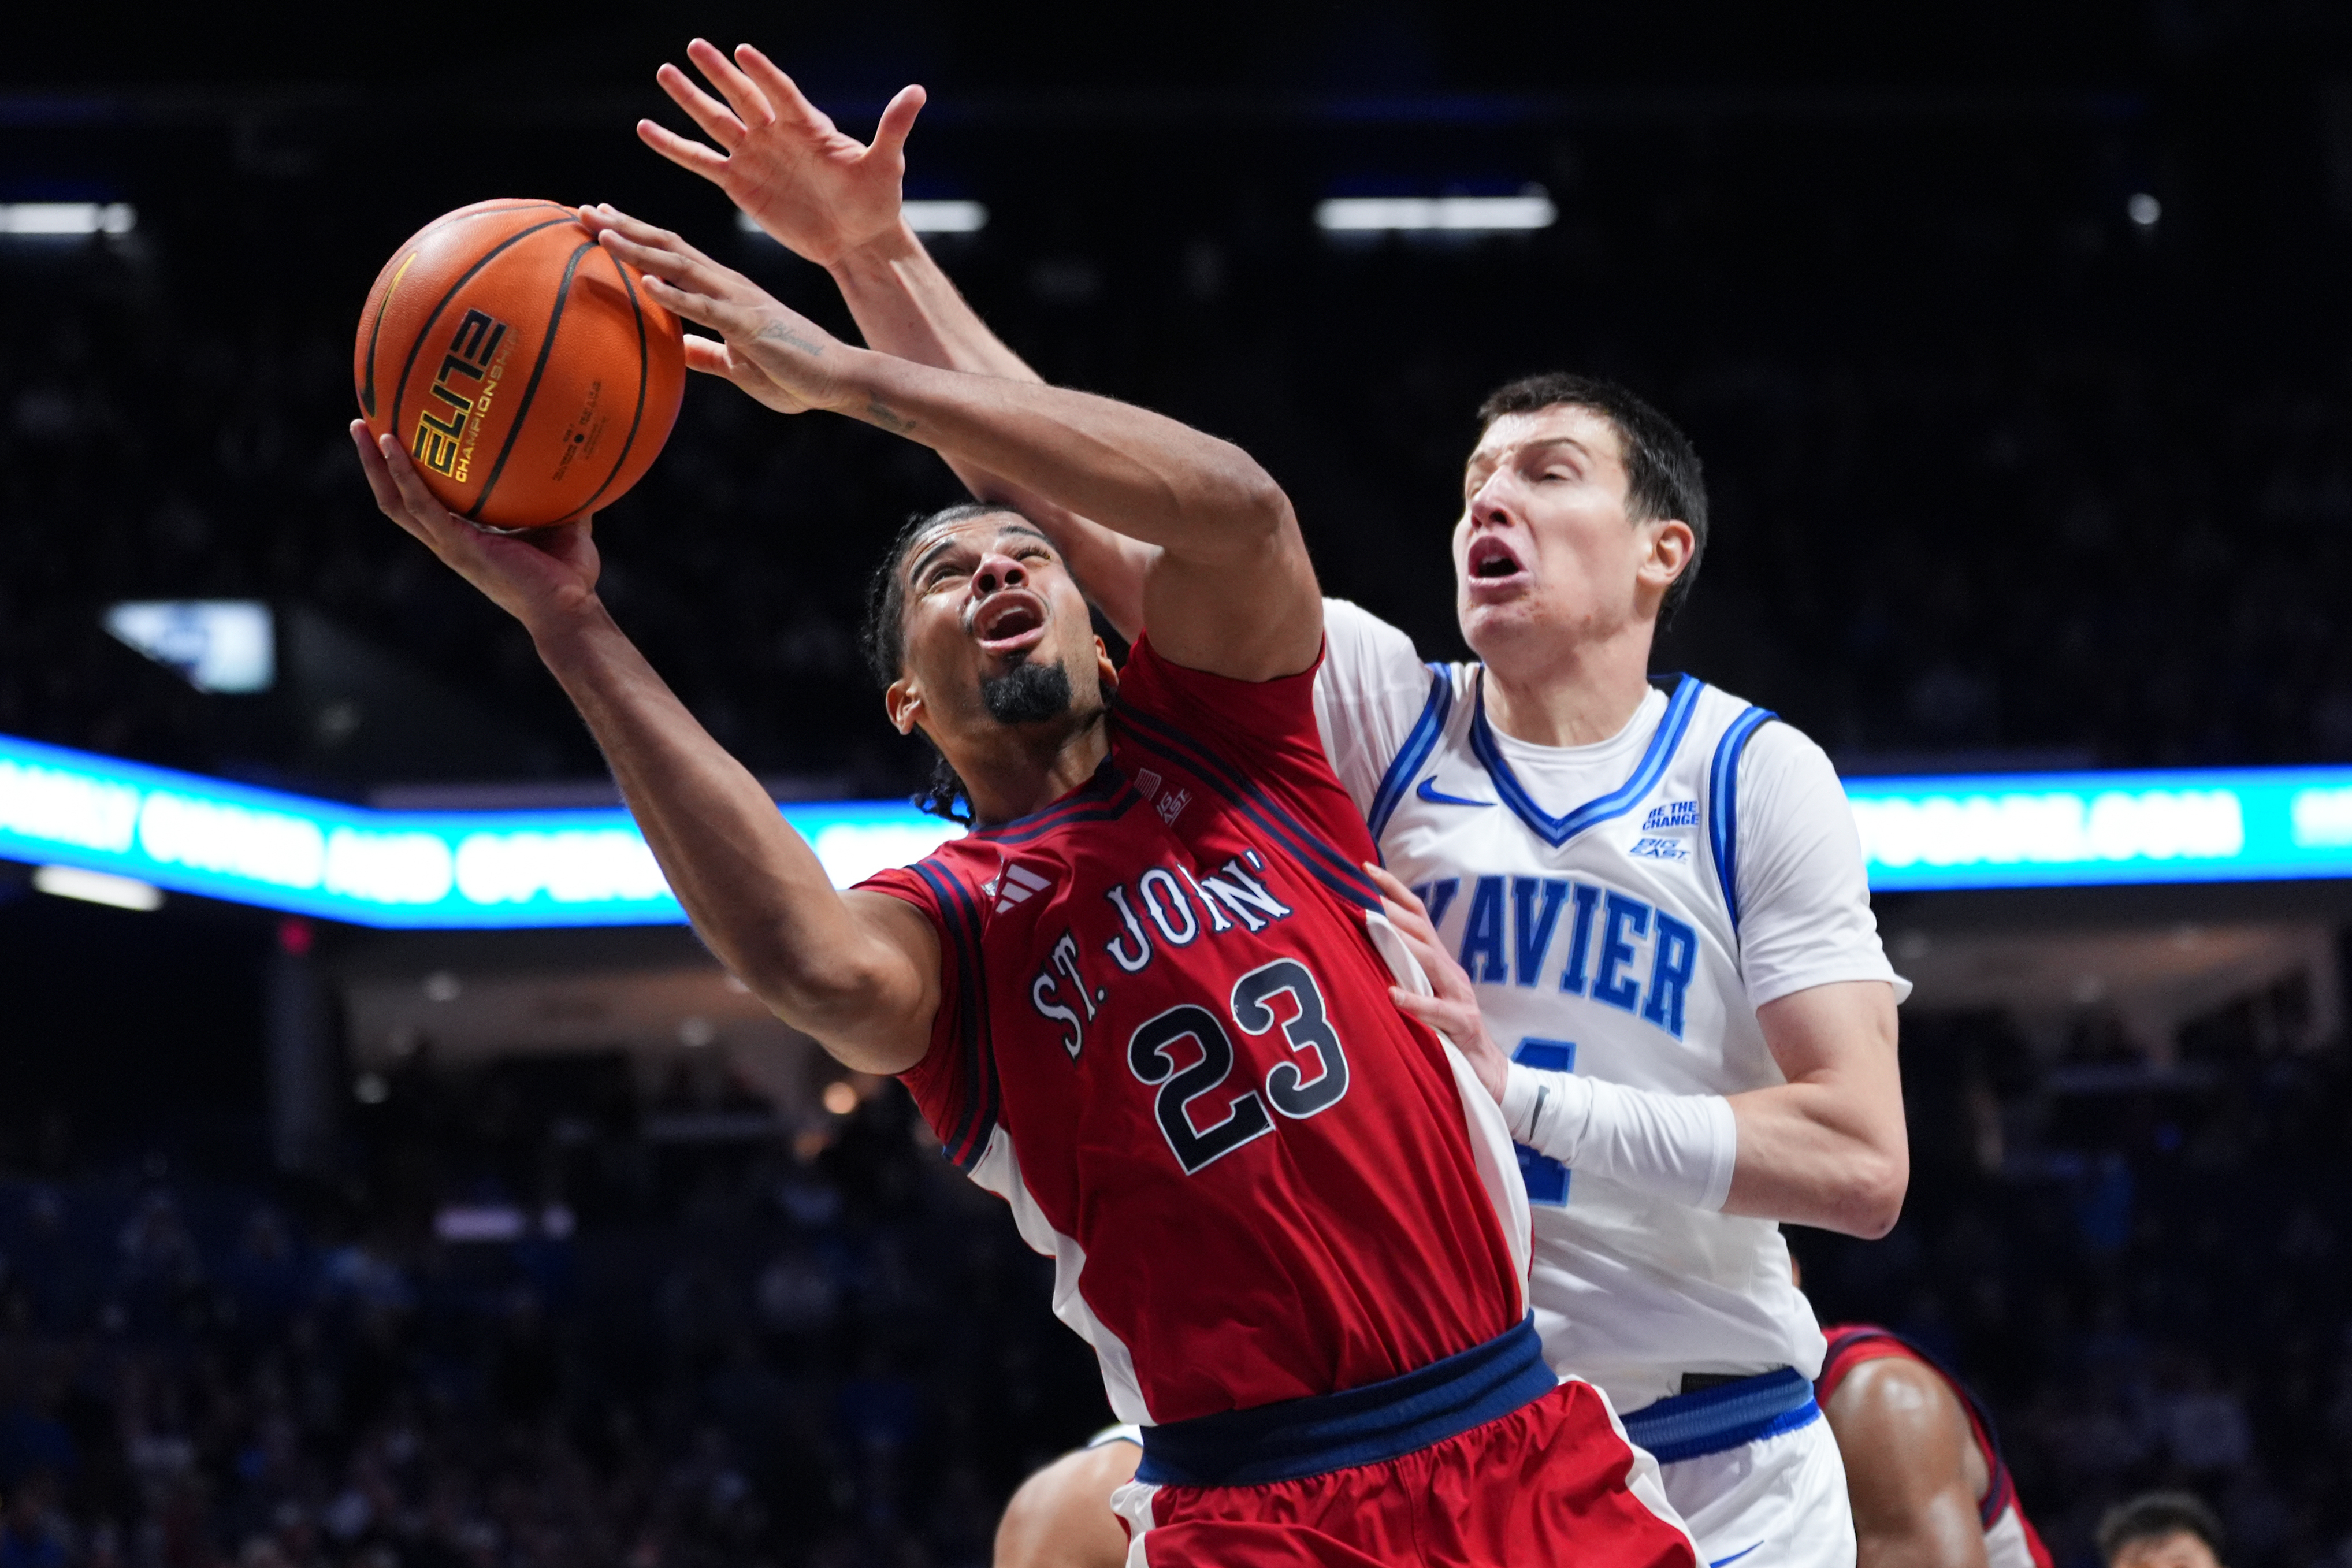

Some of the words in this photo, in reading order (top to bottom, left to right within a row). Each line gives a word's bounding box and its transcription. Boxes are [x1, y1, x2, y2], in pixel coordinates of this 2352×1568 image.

[413, 307, 508, 477] ELITE
[1642, 813, 1701, 831] CHANGE
[1670, 801, 1697, 814] THE
[1030, 929, 1106, 1064] ST.
[1128, 958, 1349, 1176] 23
